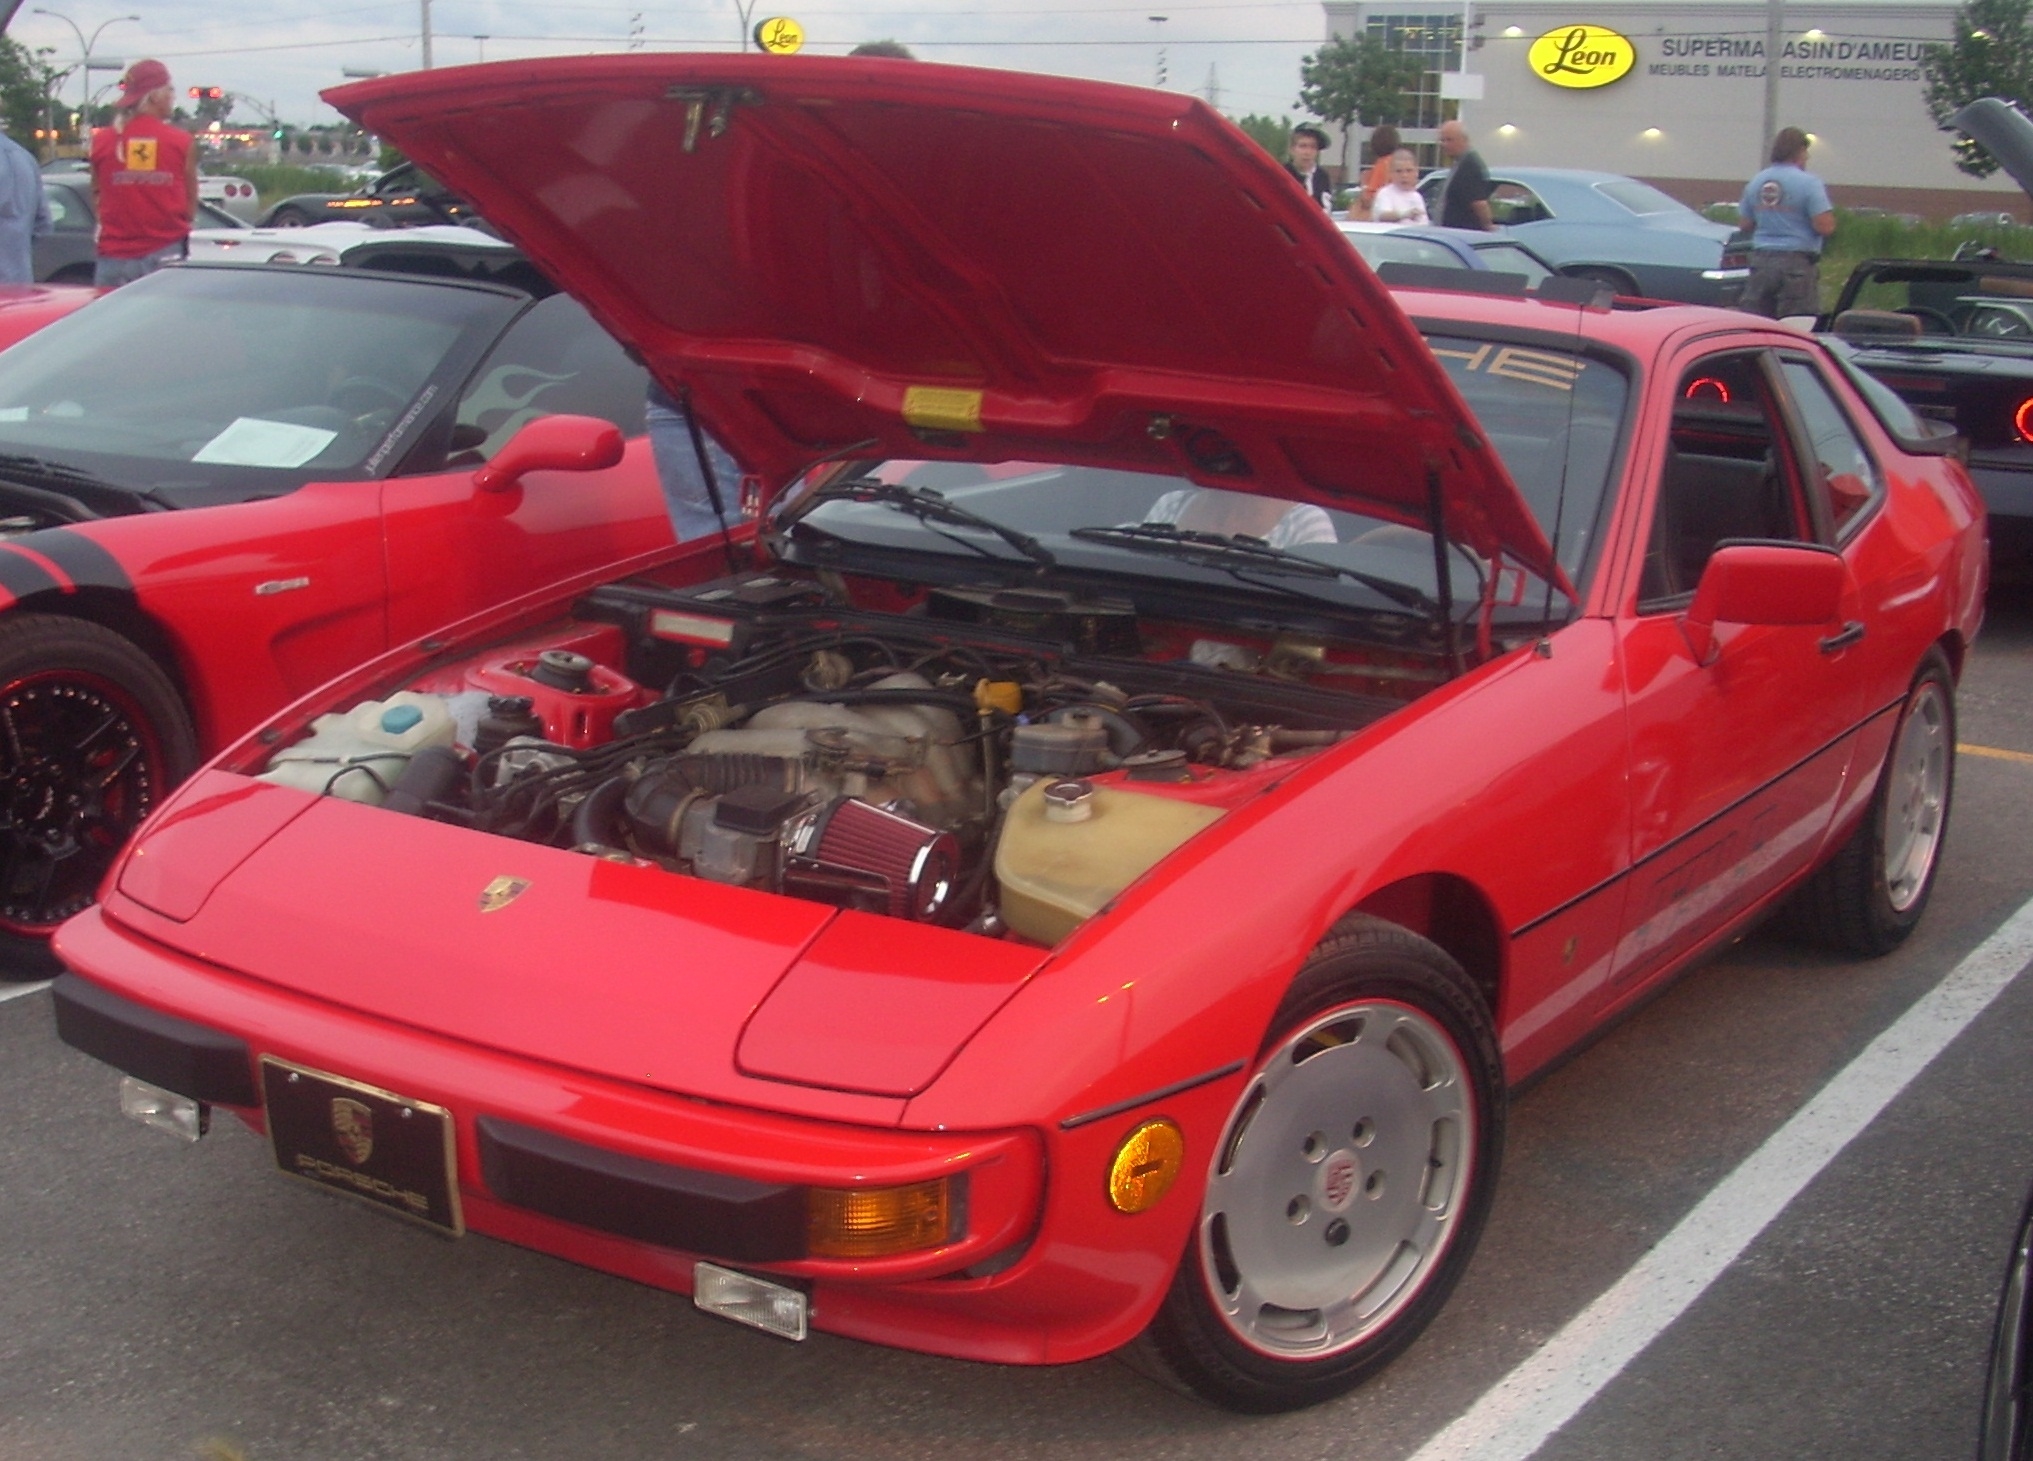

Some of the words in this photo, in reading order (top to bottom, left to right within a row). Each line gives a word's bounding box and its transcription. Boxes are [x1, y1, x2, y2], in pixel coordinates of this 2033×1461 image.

[1662, 38, 1833, 60] SUPERMAASIN
[1838, 41, 1921, 61] D'AMEU
[1648, 64, 1710, 77] MEUBLES
[1717, 65, 1767, 78] MATELA
